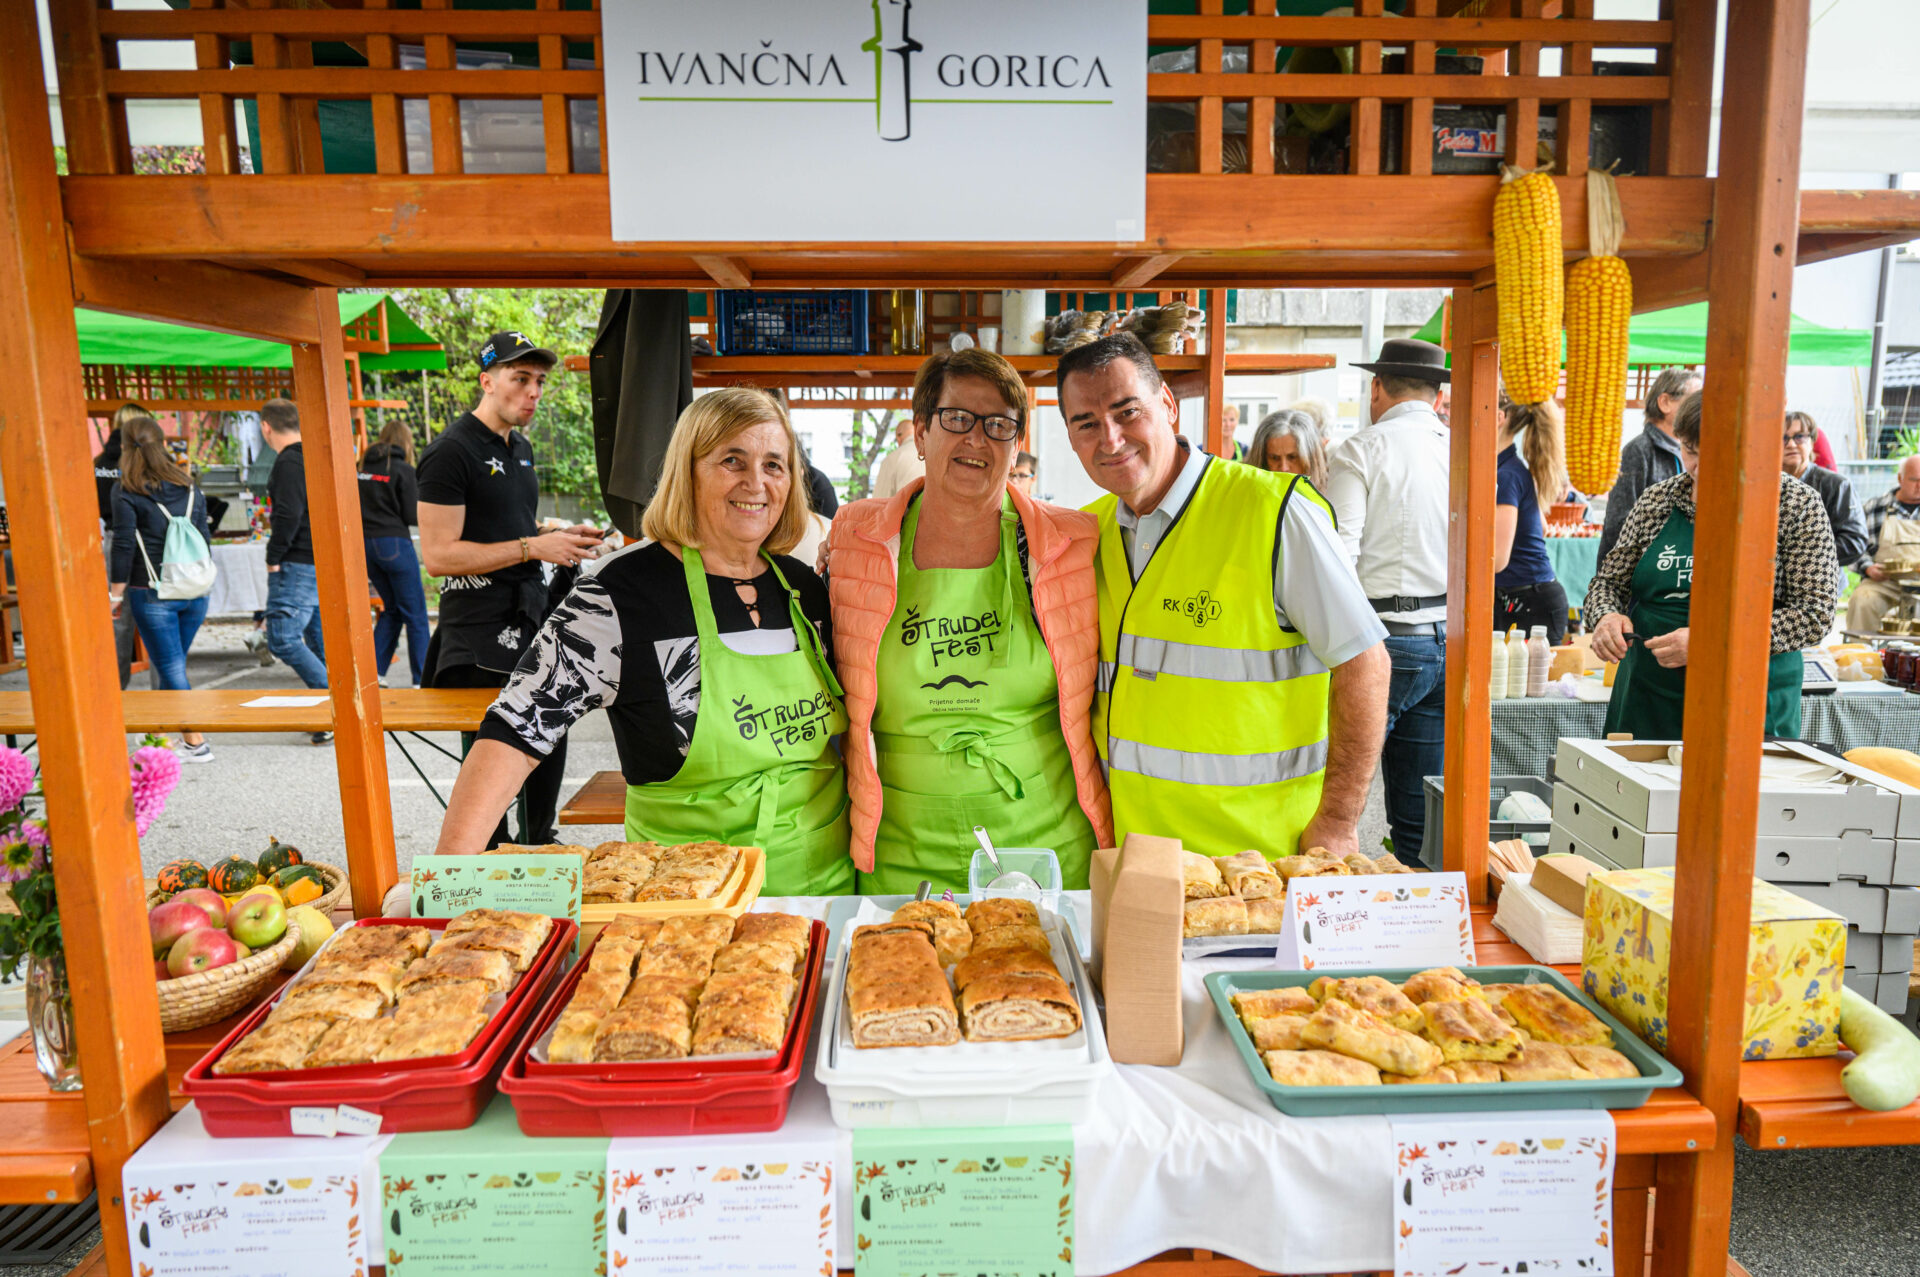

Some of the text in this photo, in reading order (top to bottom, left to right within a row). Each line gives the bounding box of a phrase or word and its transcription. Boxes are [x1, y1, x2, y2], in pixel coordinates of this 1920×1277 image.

[637, 39, 1112, 88] IVANČNA GORICA
[1162, 598, 1180, 612] RK
